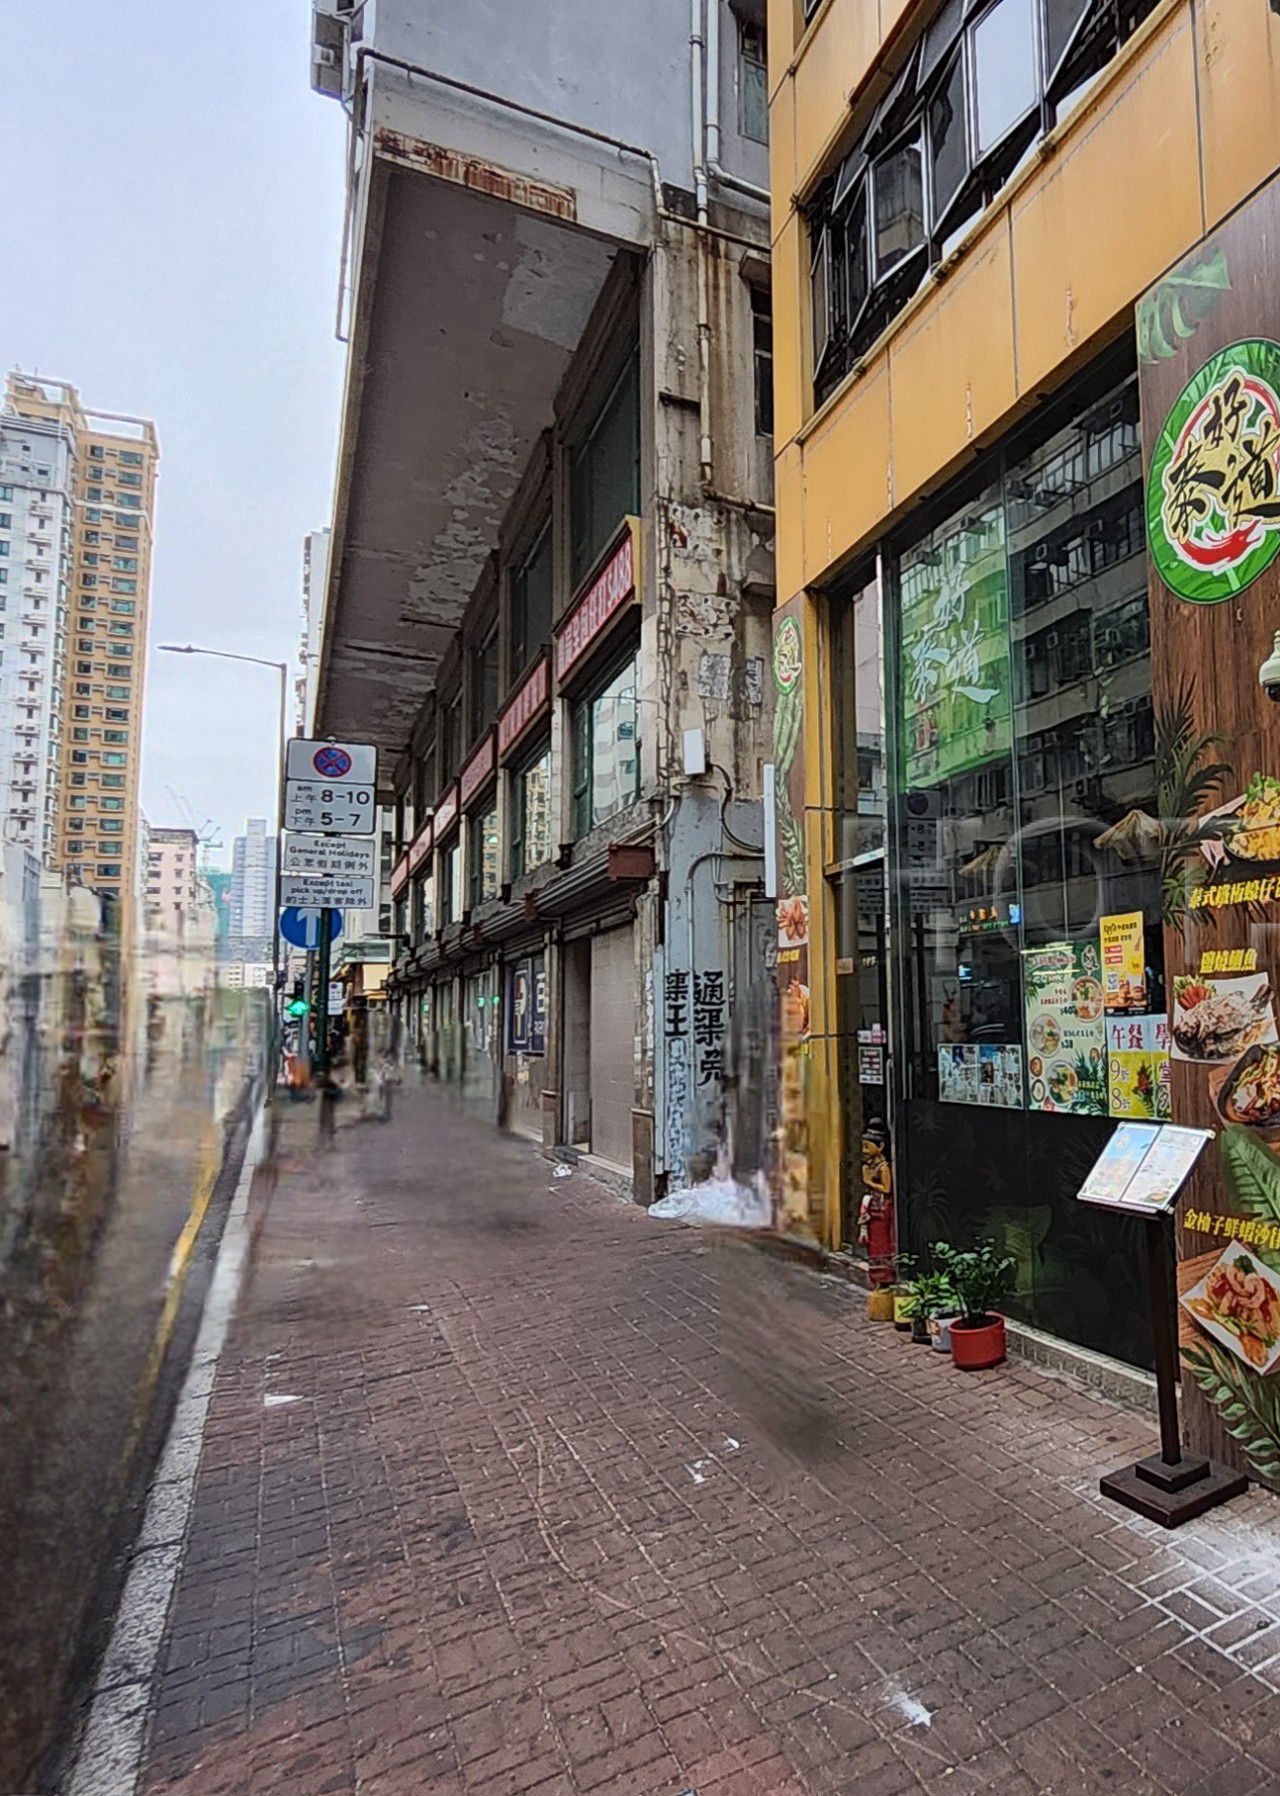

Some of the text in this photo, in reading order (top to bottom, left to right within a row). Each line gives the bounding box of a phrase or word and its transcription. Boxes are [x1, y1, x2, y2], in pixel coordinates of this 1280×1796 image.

[291, 789, 370, 804] 上午 8-10
[295, 808, 312, 816] pm
[291, 816, 317, 826] 下午
[314, 839, 346, 849] Except
[289, 846, 370, 859] General Holidays
[303, 878, 333, 887] Except
[291, 887, 310, 895] pick
